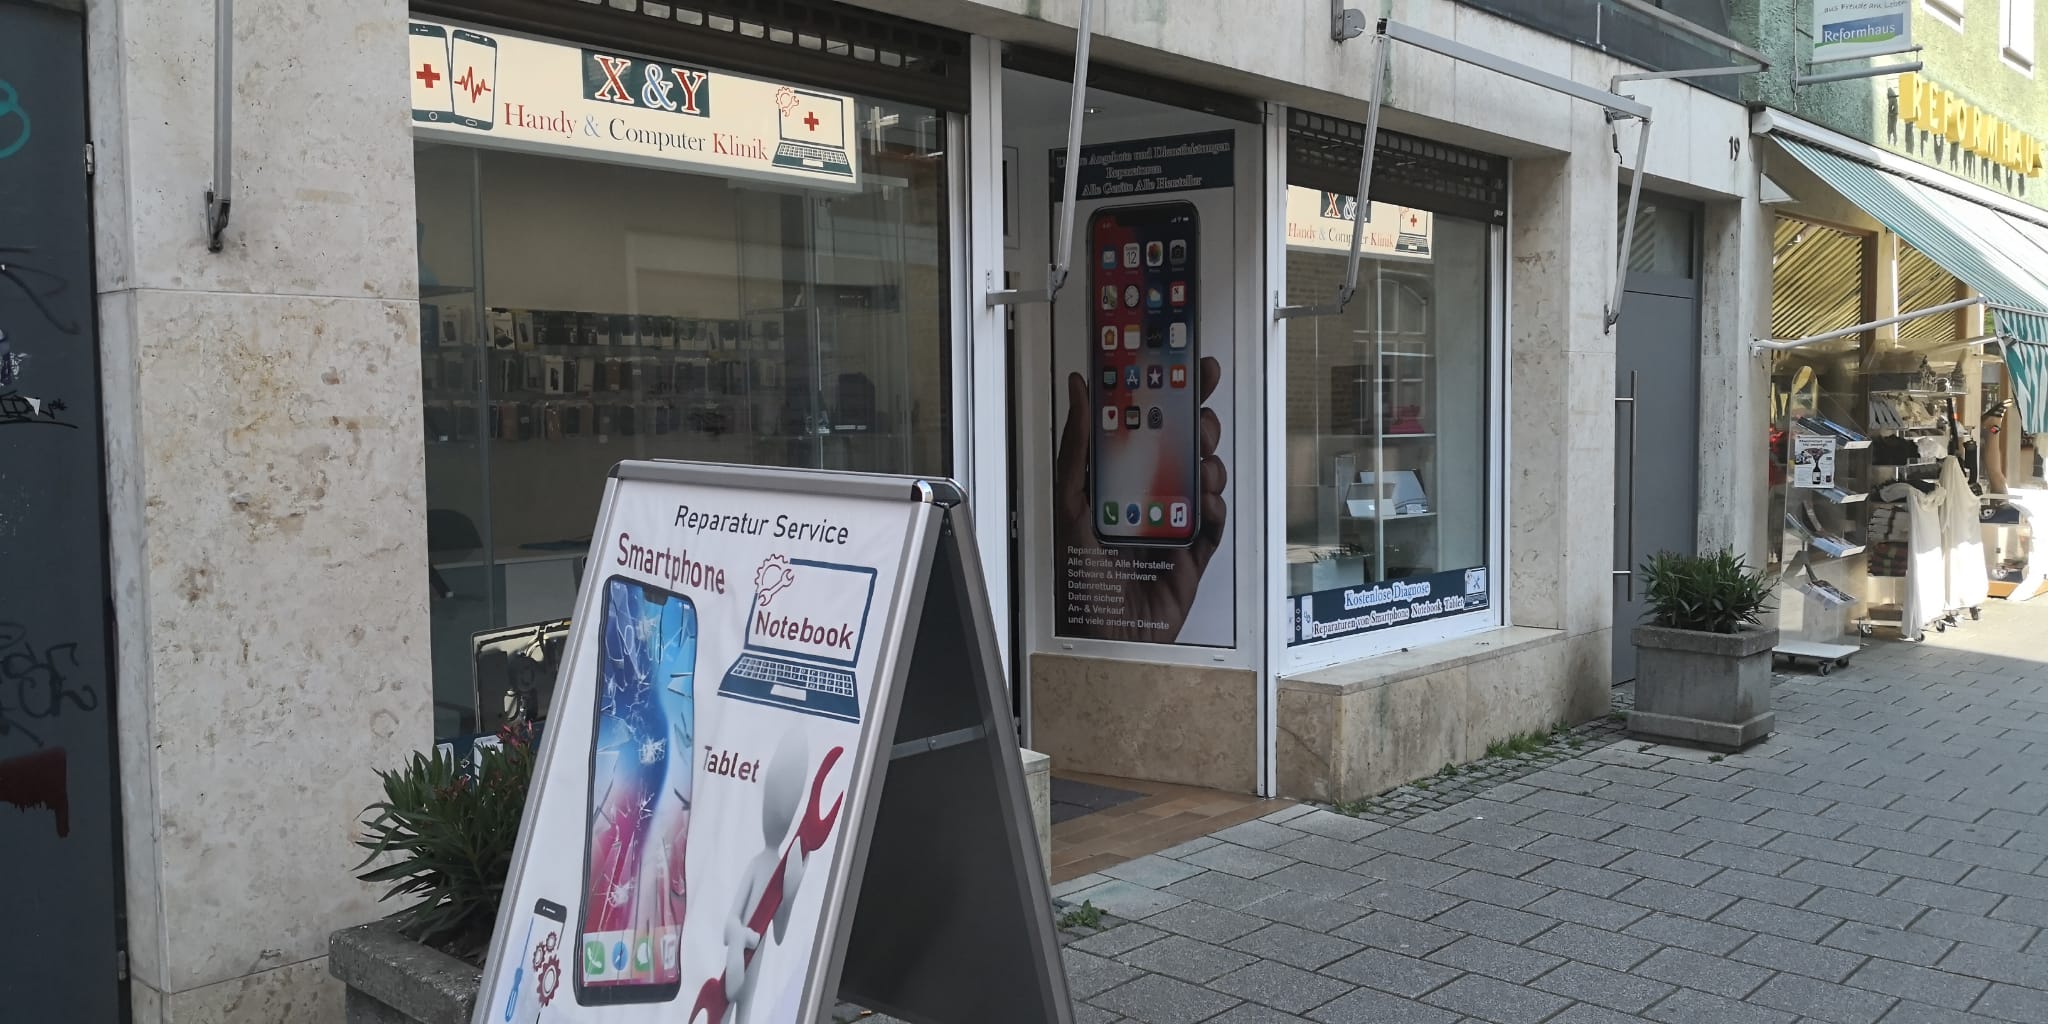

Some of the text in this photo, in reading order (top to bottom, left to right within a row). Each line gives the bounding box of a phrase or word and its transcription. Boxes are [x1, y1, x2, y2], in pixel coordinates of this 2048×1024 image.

[1824, 24, 1896, 44] Reformhaus
[504, 102, 769, 161] Handy & Computer Klinik
[1728, 136, 1741, 162] 19
[1288, 222, 1316, 242] Handy
[1127, 250, 1137, 265] 12
[675, 505, 849, 545] Reparatur Service
[1067, 546, 1119, 556] Reparaturen
[617, 533, 726, 595] Smartphone
[1115, 560, 1131, 568] Alle
[1132, 560, 1175, 570] Hersteller
[1067, 569, 1104, 578] Software
[1115, 572, 1157, 581] Hardware
[1068, 581, 1122, 592] Datenrettung
[1345, 582, 1430, 610] Kostenlose Diagnose
[1068, 592, 1125, 603] Daten sichern
[1092, 605, 1126, 615] Verkauf
[1313, 618, 1356, 638] Reparaturen
[1370, 608, 1410, 627] Smartphone
[1411, 600, 1442, 618] Notebook
[755, 611, 854, 650] Notebook
[1068, 616, 1170, 630] und viele andere Dienste
[704, 745, 760, 783] Tablet
